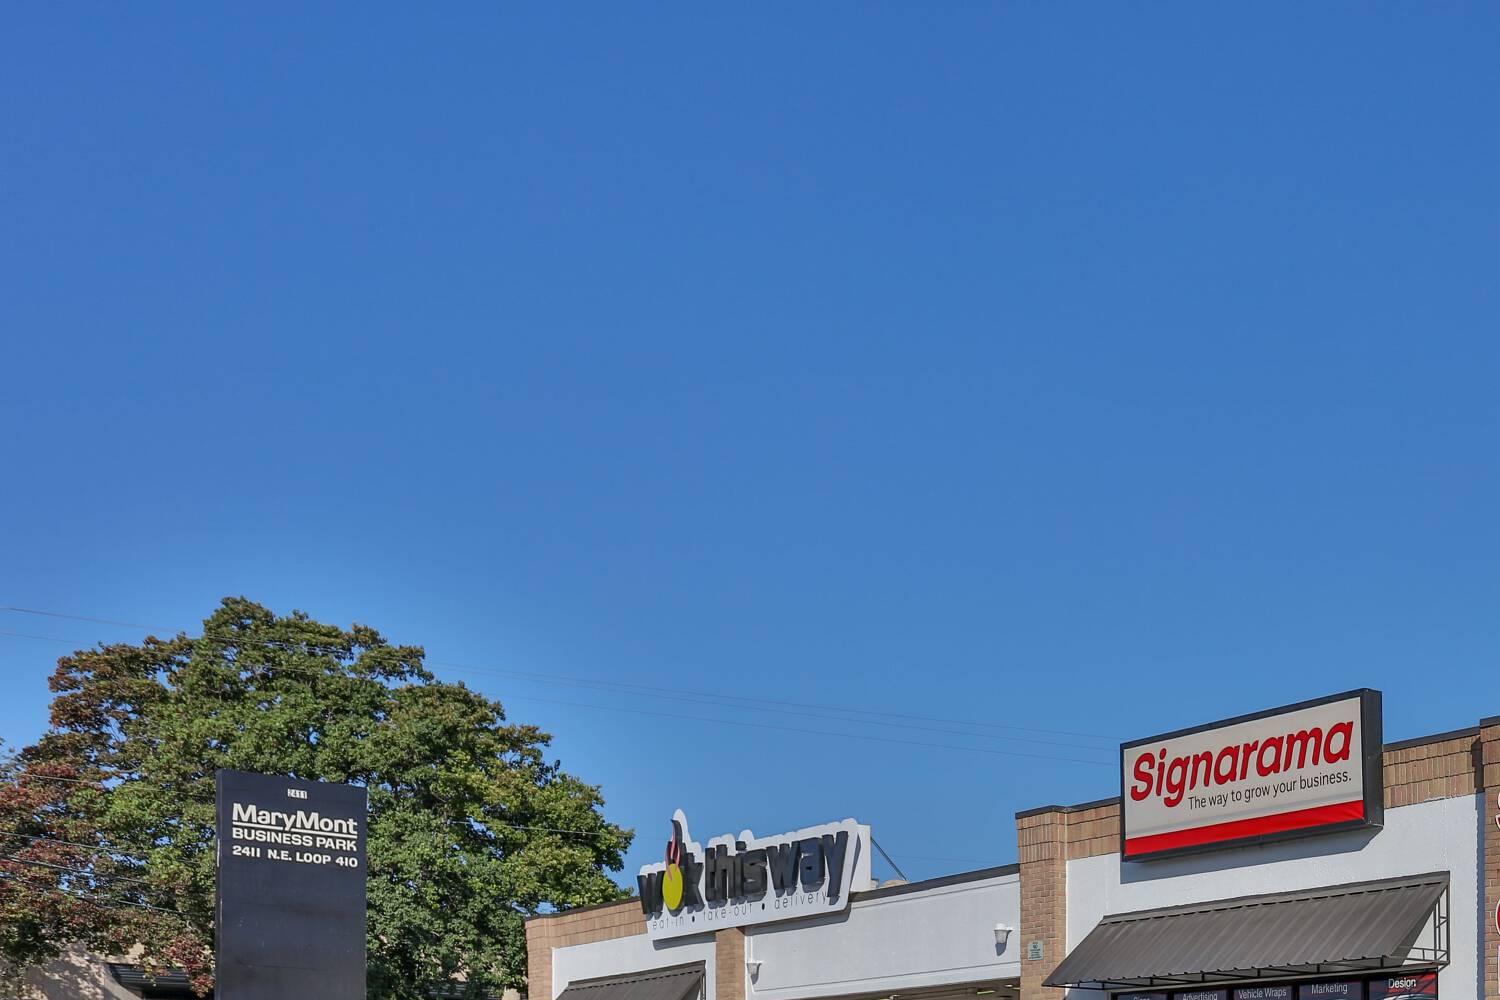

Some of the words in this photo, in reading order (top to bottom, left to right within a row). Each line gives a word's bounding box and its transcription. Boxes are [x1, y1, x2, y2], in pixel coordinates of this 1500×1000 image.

[1131, 721, 1353, 808] Signarama
[1188, 796, 1207, 810] The
[1208, 794, 1229, 808] way
[1231, 790, 1242, 803] to
[1244, 786, 1271, 803] grow
[1273, 780, 1299, 799] your
[1300, 770, 1352, 789] business.
[232, 803, 358, 835] MaryMont
[232, 827, 313, 847] BUSINESS
[316, 836, 357, 852] PARK
[232, 845, 261, 858] 2411
[267, 849, 293, 861] N.E.
[296, 851, 331, 865] LOOP
[335, 856, 358, 868] 410
[705, 841, 767, 904] this
[766, 831, 849, 898] way
[652, 915, 685, 931] eat-in
[703, 901, 752, 921] take-out
[774, 889, 828, 910] delivery
[1239, 989, 1263, 999] Vehicle
[1264, 988, 1287, 999] Wraps
[1311, 984, 1348, 995] Marketing
[1388, 978, 1416, 989] Design
